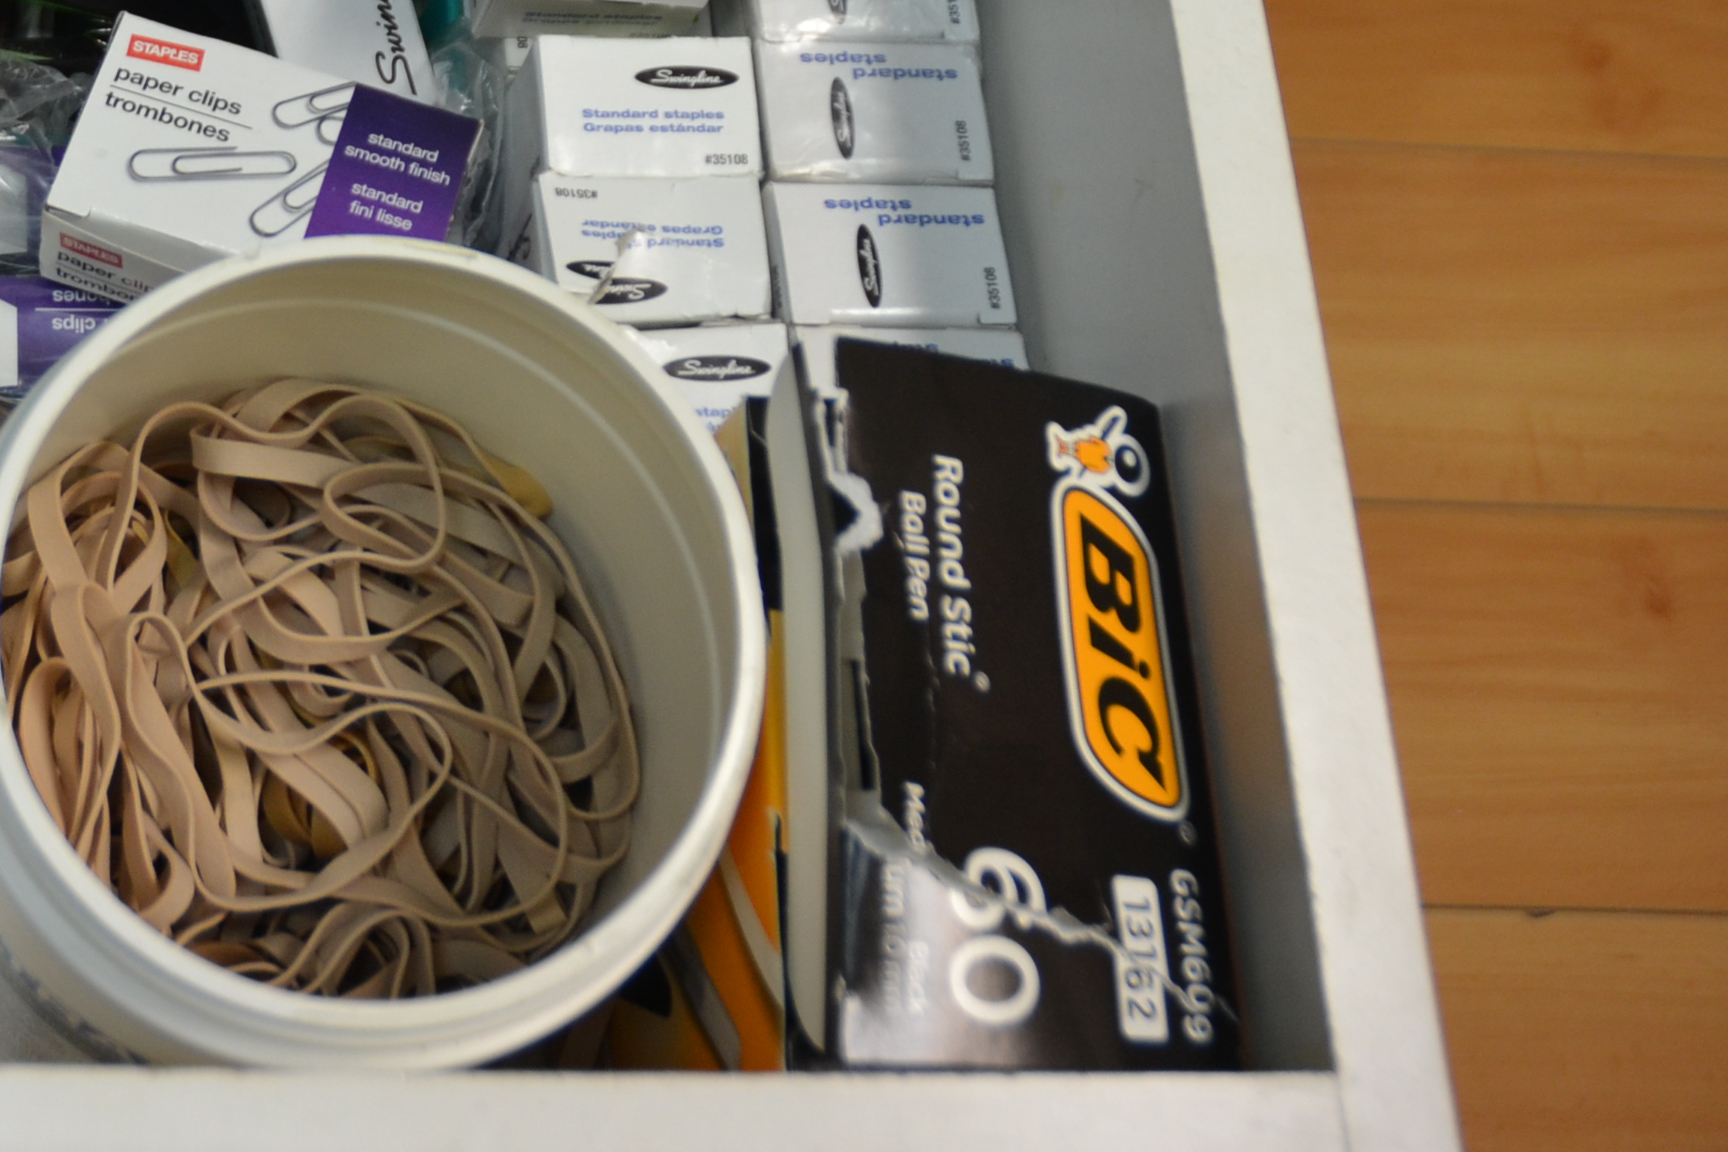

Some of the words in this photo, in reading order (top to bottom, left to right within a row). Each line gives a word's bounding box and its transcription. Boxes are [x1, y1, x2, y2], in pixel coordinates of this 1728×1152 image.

[133, 39, 200, 65] STAPLES
[799, 52, 887, 65] staples
[649, 68, 724, 88] Swingline
[852, 67, 959, 81] standard
[113, 67, 184, 96] paper
[188, 89, 242, 115] clips
[105, 91, 231, 143] trombones
[582, 108, 660, 119] Standard
[664, 109, 725, 121] staples
[583, 122, 644, 134] Grapas
[649, 121, 724, 133] estándar
[367, 133, 440, 163] standard
[955, 120, 971, 162] #35108
[344, 145, 406, 172] smooth
[407, 162, 451, 186] finish
[705, 154, 749, 165] #35108
[351, 183, 424, 214] standard
[554, 187, 598, 199] #35108
[824, 198, 912, 211] staples
[349, 200, 374, 219] fini
[376, 208, 413, 232] lisse
[661, 225, 724, 236] Grapas
[878, 214, 985, 227] standard
[62, 236, 120, 265] STAPLES
[647, 237, 725, 249] Standard
[57, 251, 117, 279] paper
[56, 267, 137, 302] trombo
[984, 266, 1001, 310] #35108
[52, 317, 96, 334] clips
[677, 359, 756, 379] Swingline
[900, 490, 930, 554] Ball
[933, 453, 972, 590] Round
[905, 556, 930, 621] Pen
[940, 594, 976, 678] Stic
[1120, 895, 1157, 1023] 13162
[1170, 868, 1215, 1044] GSM609
